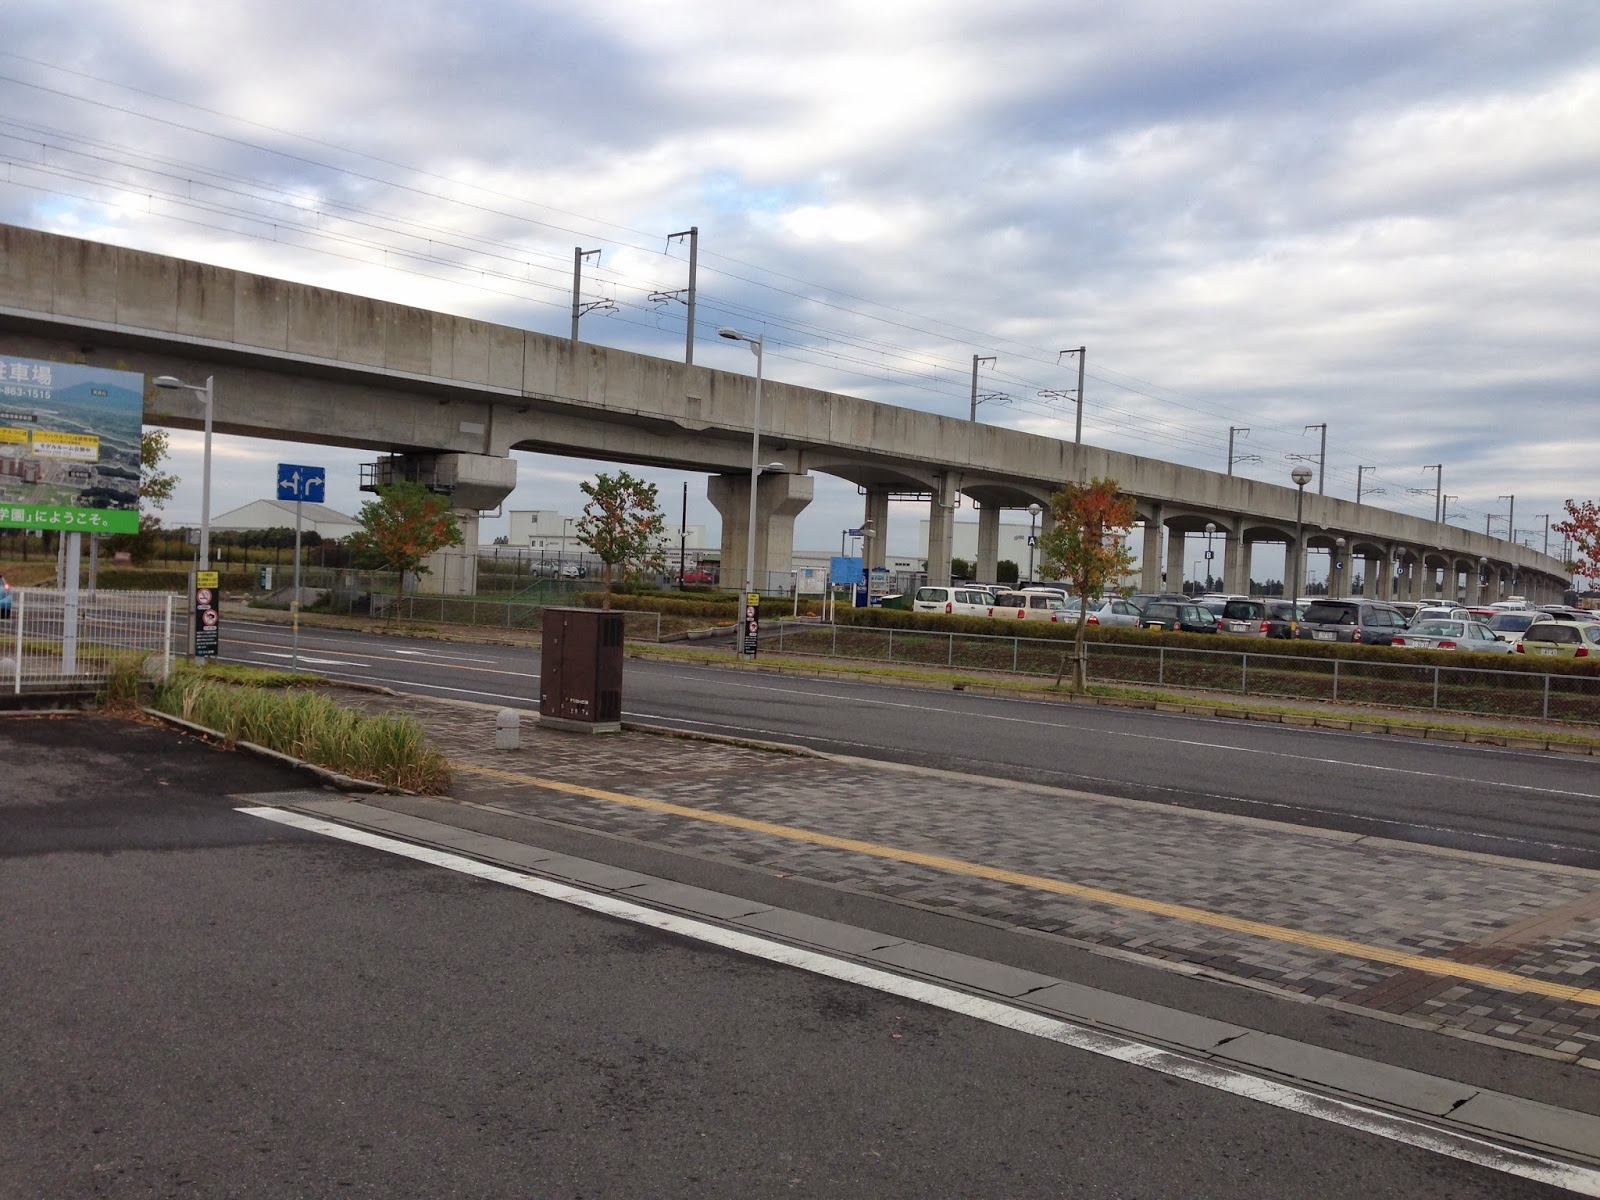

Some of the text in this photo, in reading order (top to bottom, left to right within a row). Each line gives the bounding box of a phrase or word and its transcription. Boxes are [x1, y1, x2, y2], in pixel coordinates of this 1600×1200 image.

[0, 508, 108, 527] 学園」にようこそ。
[1029, 537, 1035, 545] A
[1206, 551, 1212, 559] B
